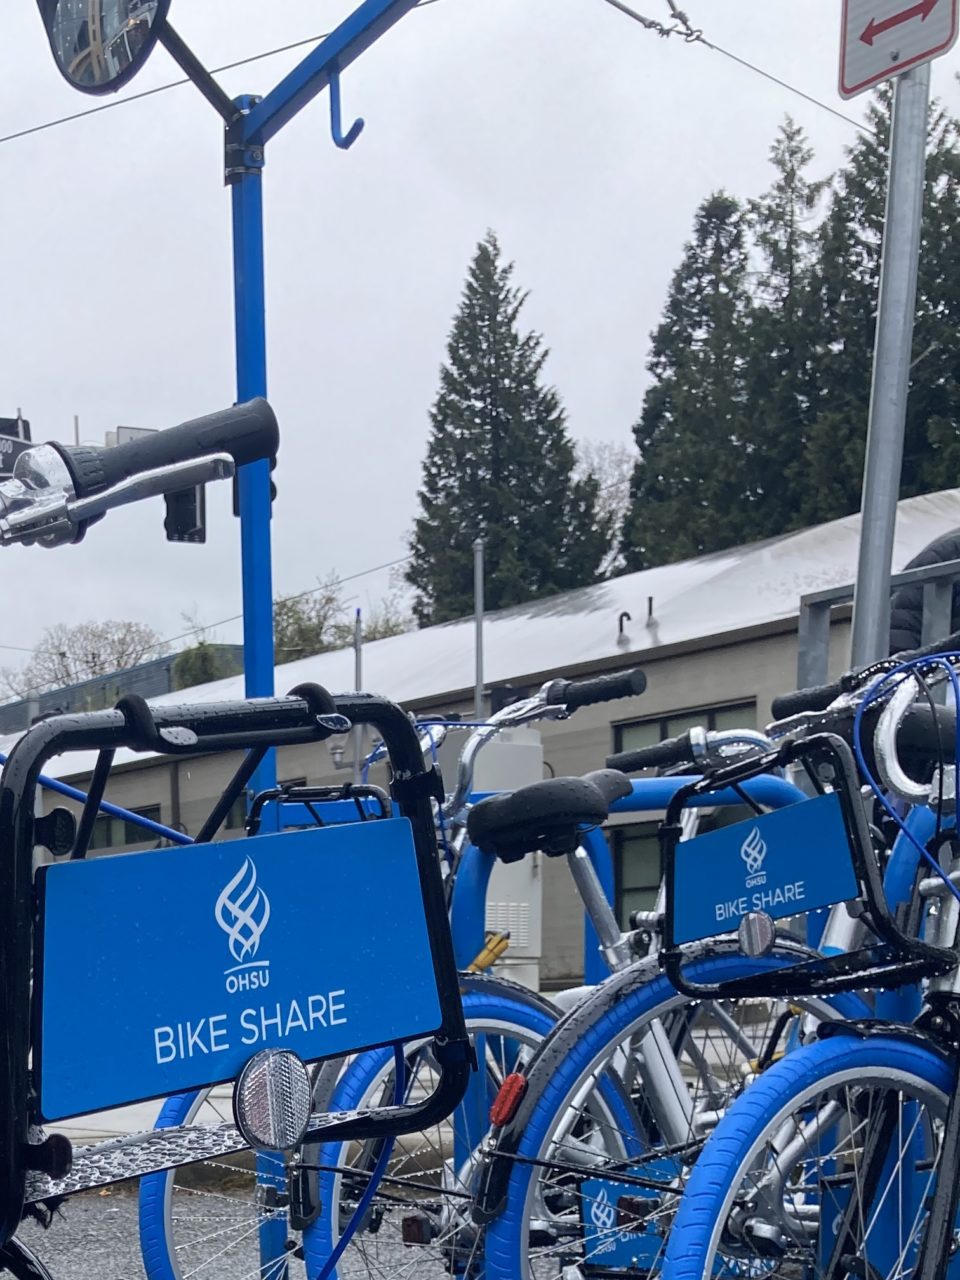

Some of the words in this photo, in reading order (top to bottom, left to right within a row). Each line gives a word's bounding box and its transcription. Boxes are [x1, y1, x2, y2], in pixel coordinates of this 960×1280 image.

[746, 875, 767, 889] OHSU
[715, 896, 749, 921] BIKE
[752, 881, 806, 911] SHARE
[225, 969, 270, 994] OHSU
[154, 1014, 230, 1065] BIKE
[240, 989, 348, 1045] SHARE
